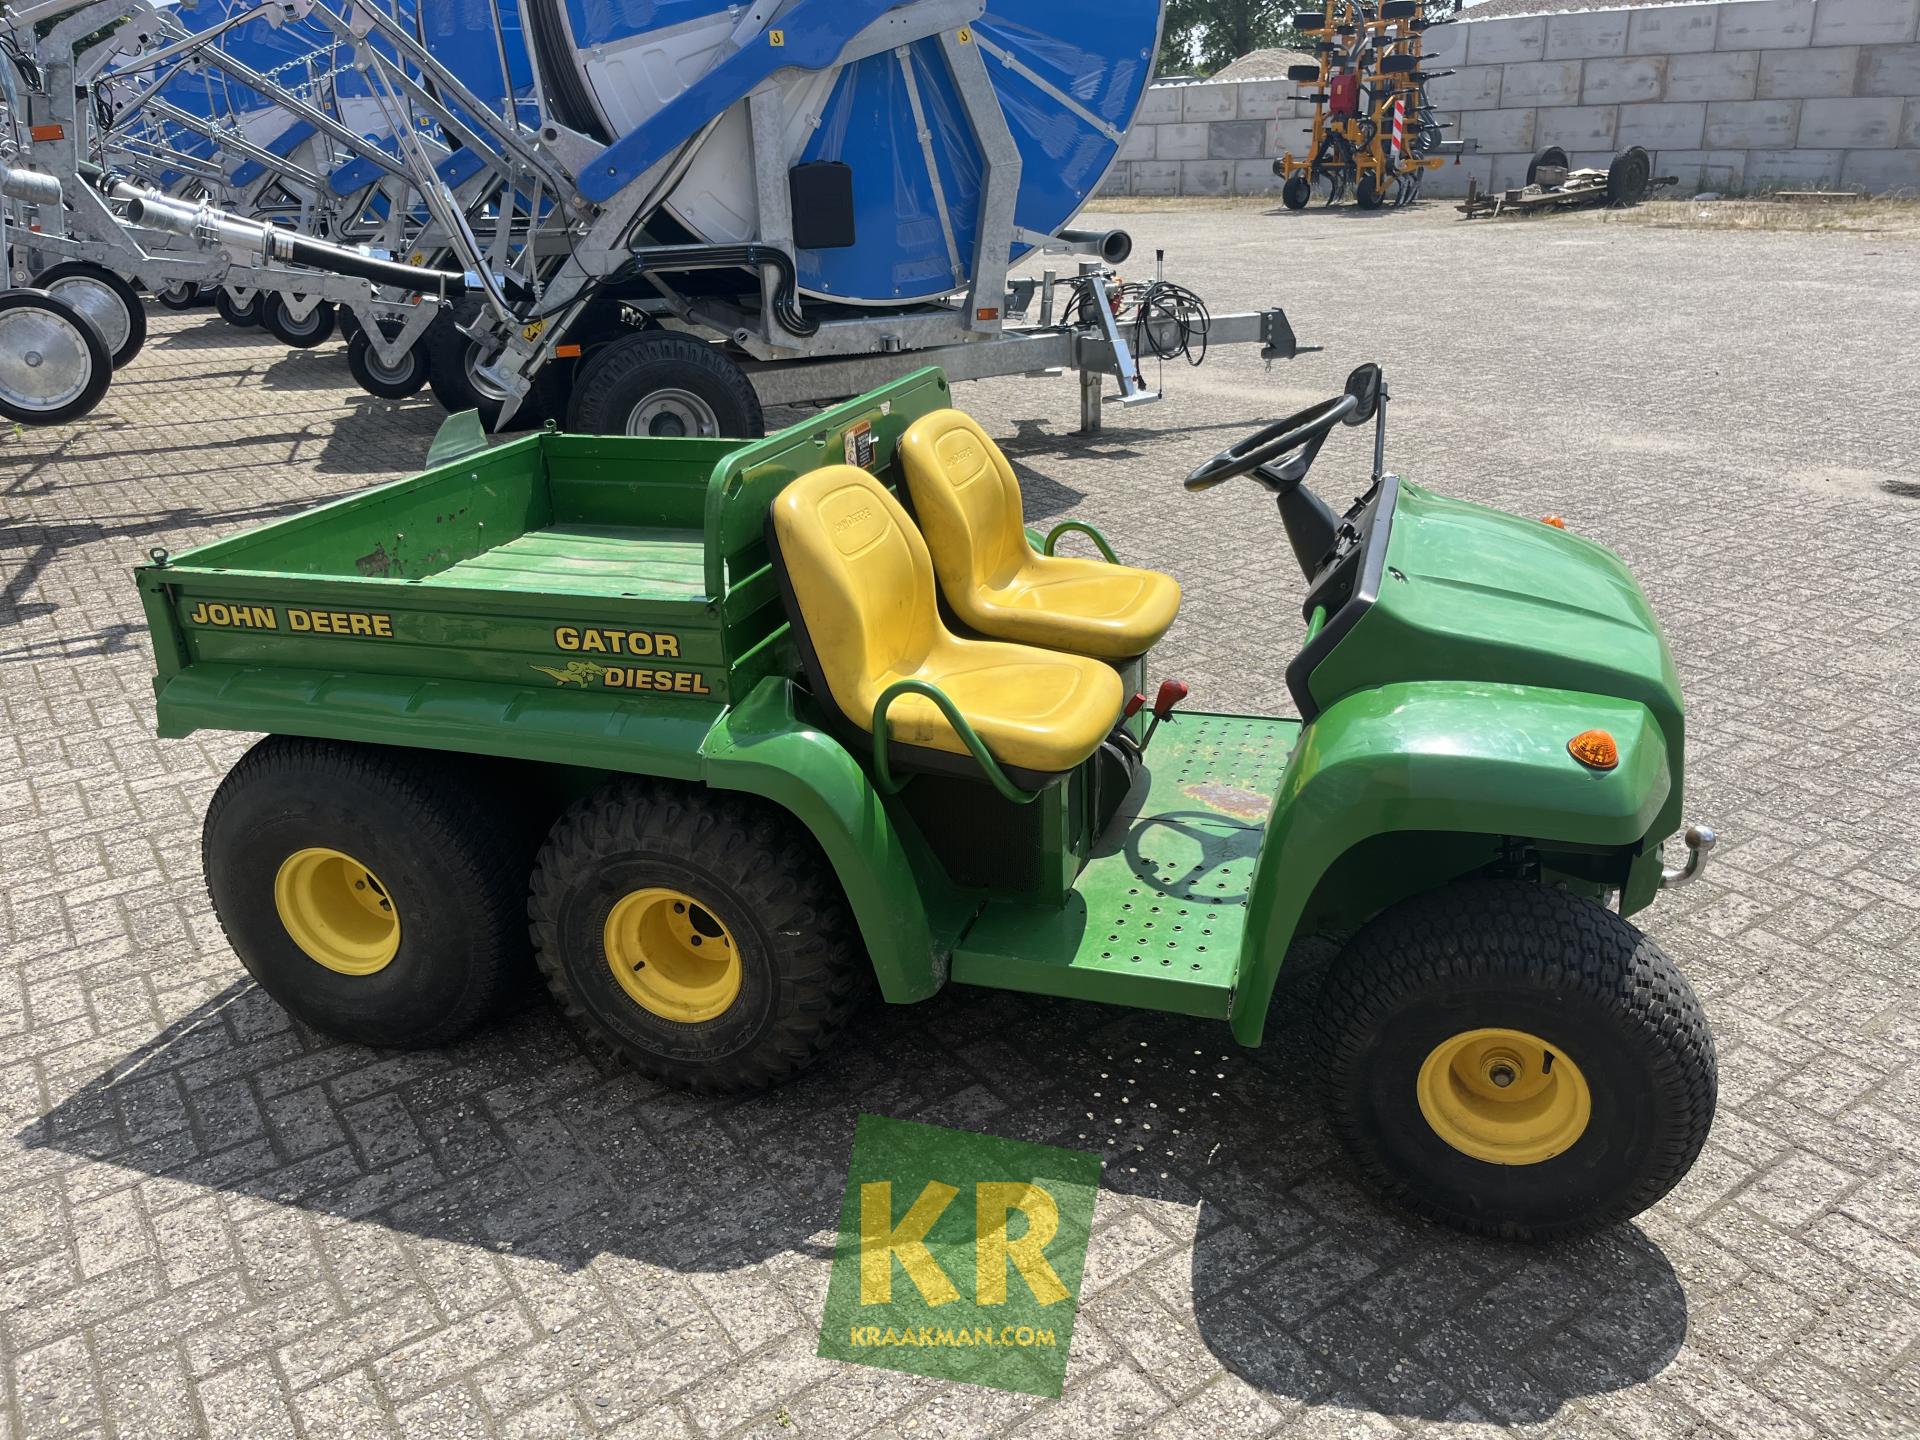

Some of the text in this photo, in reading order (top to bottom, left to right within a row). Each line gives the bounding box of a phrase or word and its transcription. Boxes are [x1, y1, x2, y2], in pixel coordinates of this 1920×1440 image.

[190, 602, 393, 638] JOHN DEERE
[554, 626, 680, 658] GATOR
[603, 666, 711, 695] DIESEL
